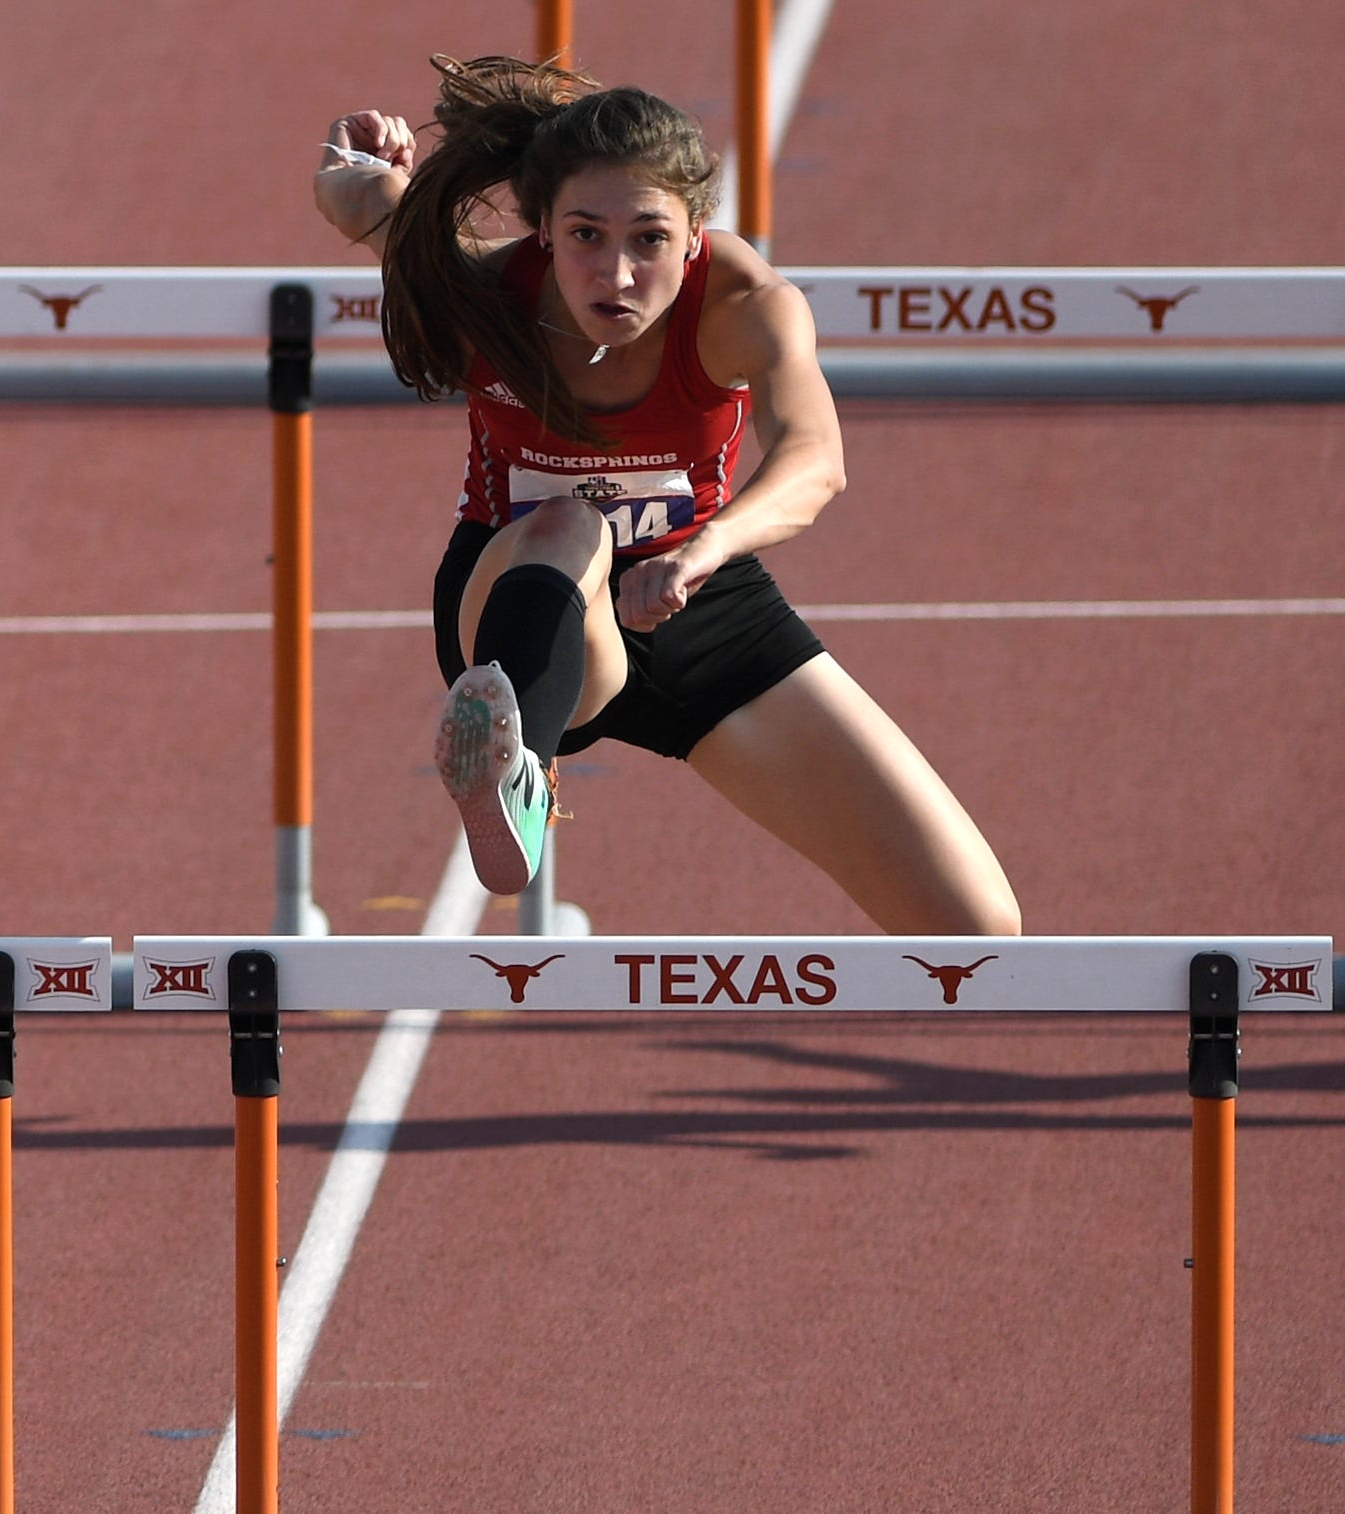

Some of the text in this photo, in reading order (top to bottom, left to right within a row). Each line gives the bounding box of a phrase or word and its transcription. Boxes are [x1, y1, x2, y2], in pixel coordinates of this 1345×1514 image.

[330, 293, 380, 322] XII
[857, 286, 1056, 332] TEXAS
[521, 447, 678, 469] ROCKSPRINGS
[606, 501, 673, 548] 14
[33, 963, 94, 996] XII
[149, 962, 209, 994] XII
[614, 953, 838, 1006] TEXAS
[1254, 964, 1315, 997] XII
